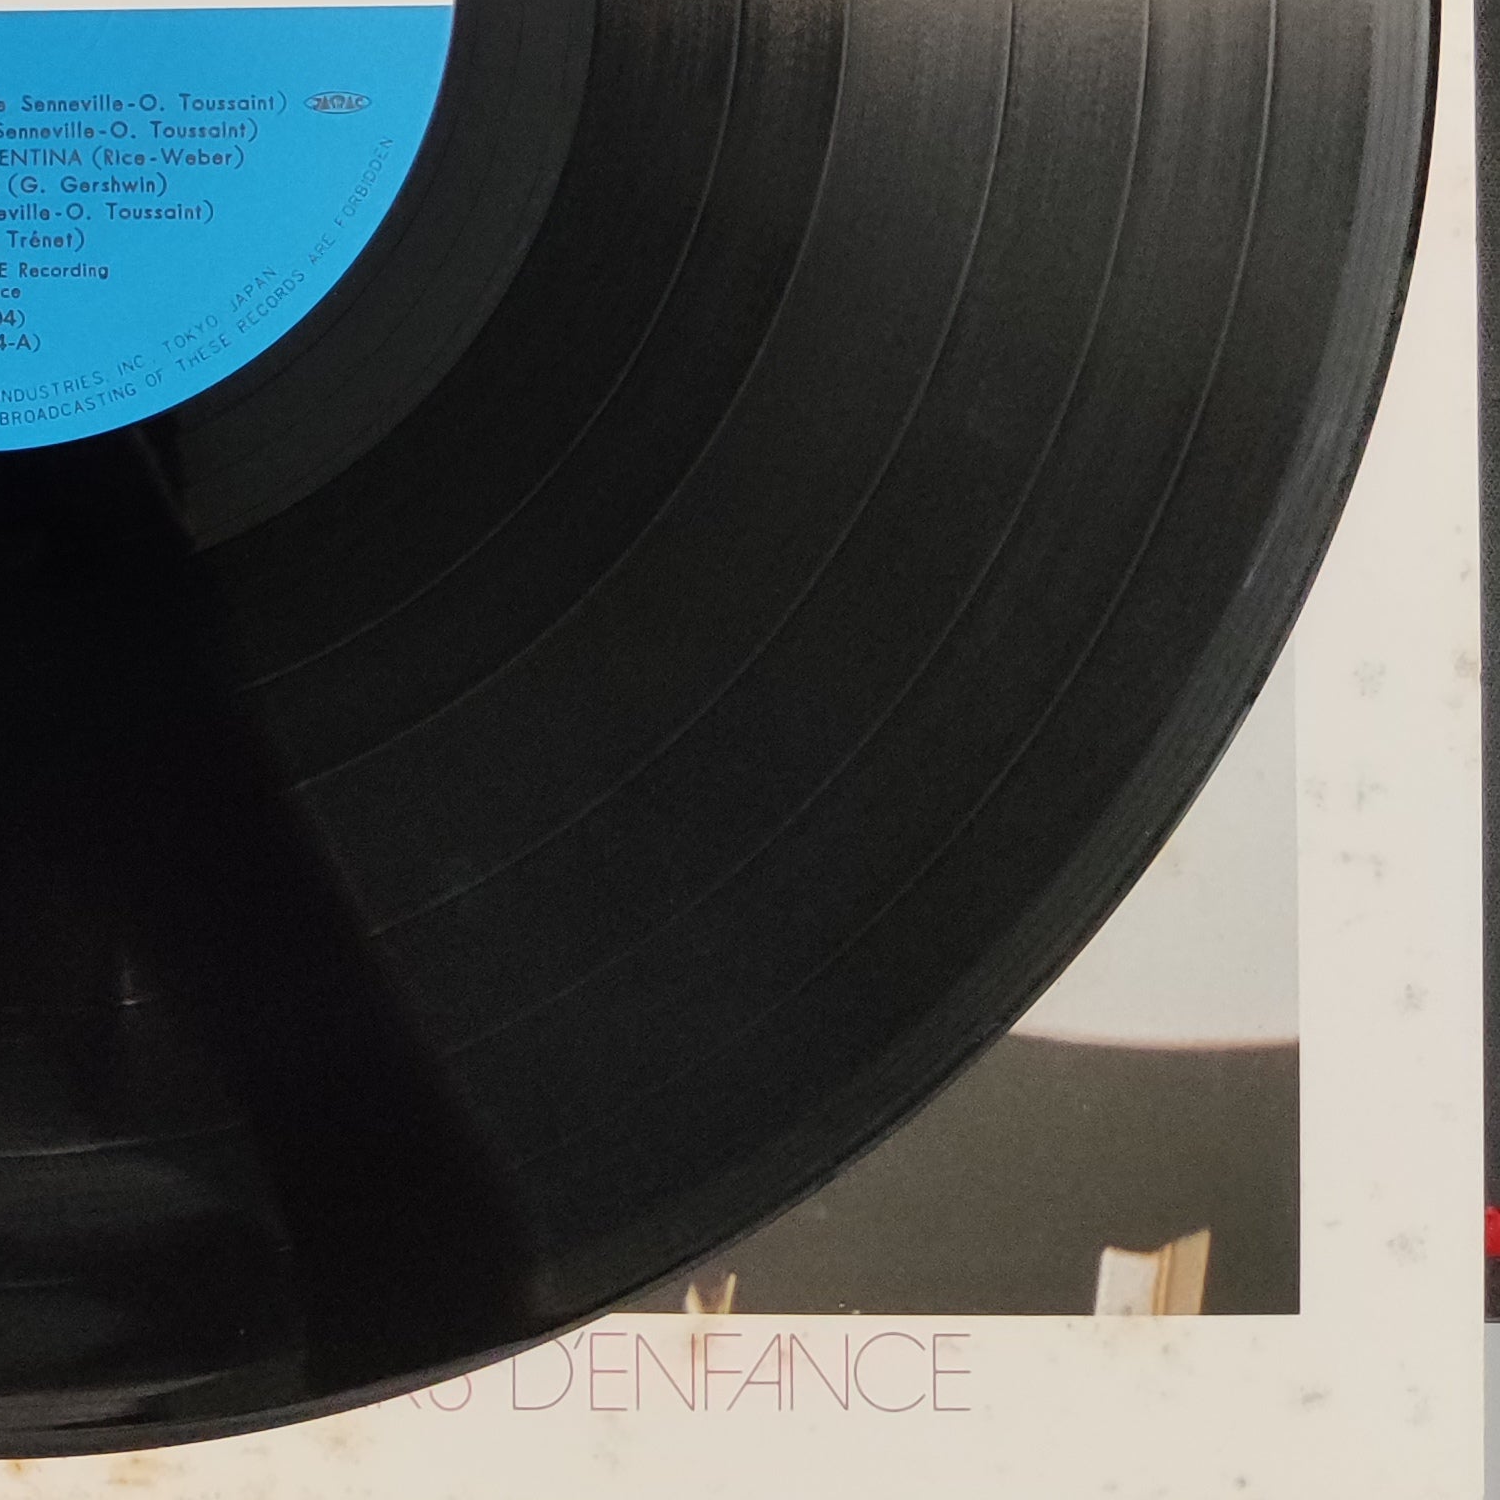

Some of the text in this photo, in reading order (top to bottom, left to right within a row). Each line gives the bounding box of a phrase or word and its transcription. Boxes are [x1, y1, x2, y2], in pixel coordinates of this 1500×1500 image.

[178, 91, 287, 114] Toussaint)
[150, 119, 259, 143] Toussaint)
[92, 145, 246, 171] (Rice-Weber)
[8, 173, 46, 198] (G.
[60, 172, 169, 198] Gershwin)
[106, 200, 215, 223] Toussaint)
[6, 227, 86, 253] Trénet)
[0, 382, 137, 427] BROADCASTING
[145, 368, 164, 387] OF
[175, 334, 233, 373] THESE
[236, 269, 305, 334] RECORDS
[308, 232, 336, 265] ARE
[334, 135, 395, 229] FORBIDDEN
[19, 263, 110, 280] Recording
[229, 266, 278, 314] JAPAN
[511, 1331, 972, 1413] D'ENFANCE
